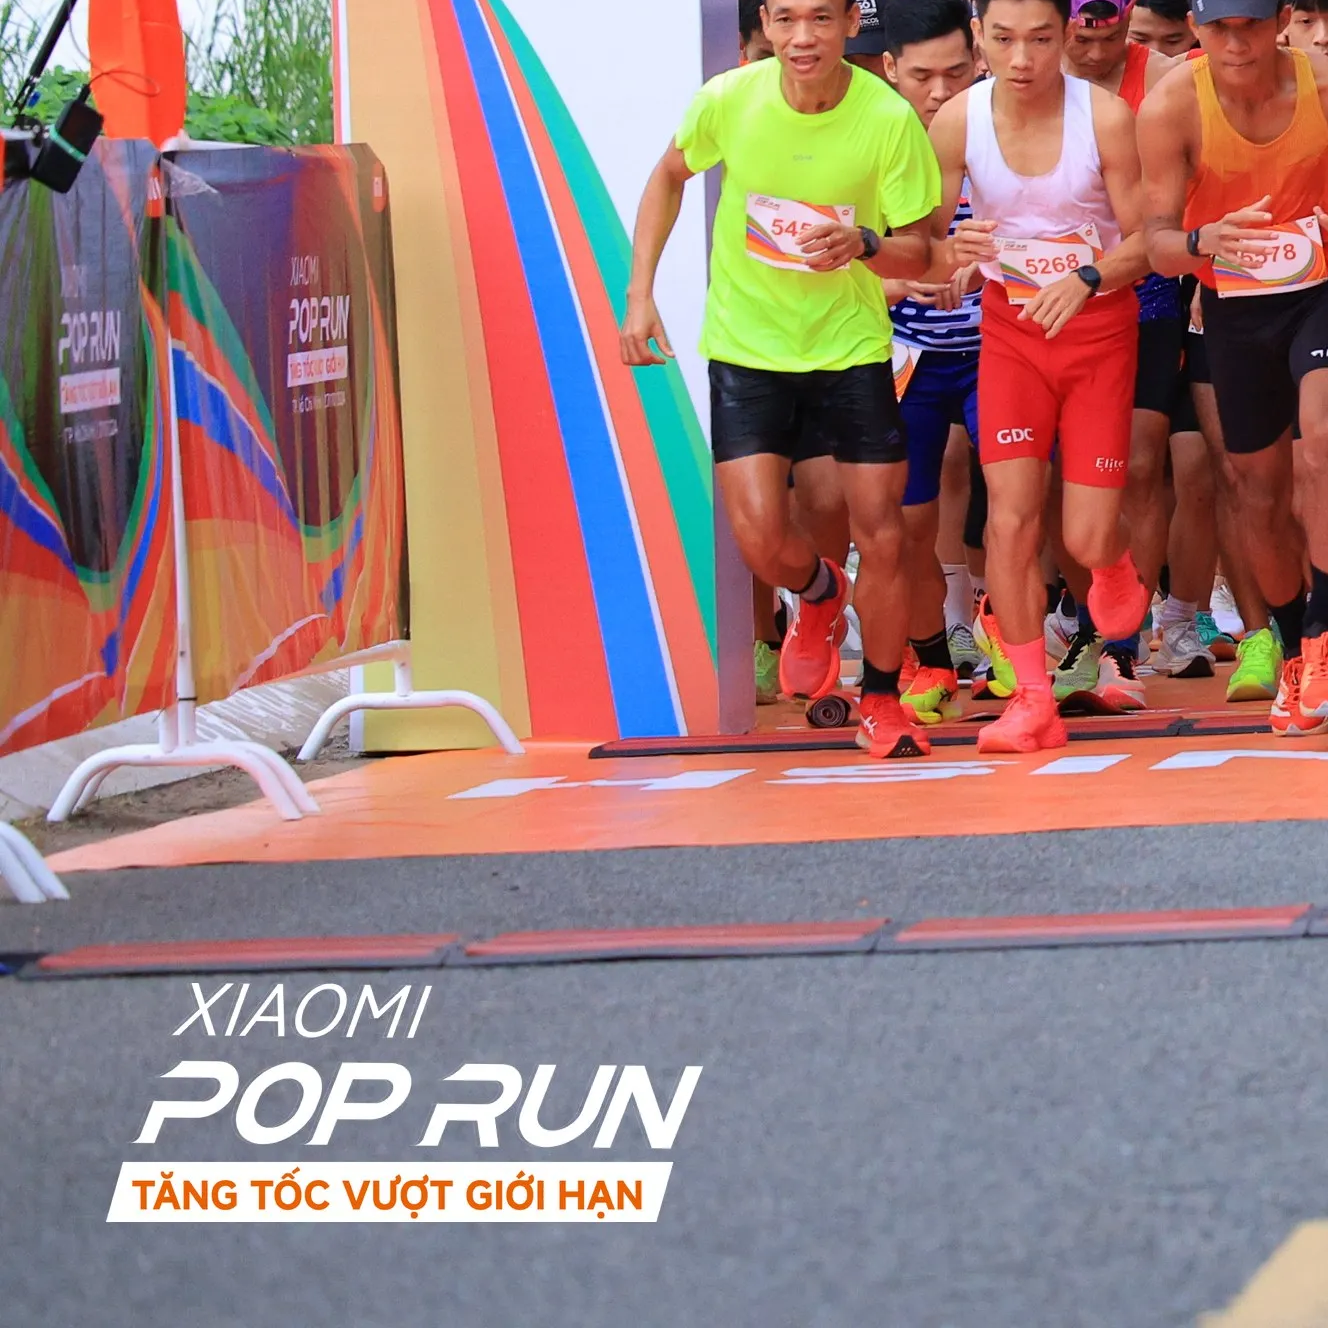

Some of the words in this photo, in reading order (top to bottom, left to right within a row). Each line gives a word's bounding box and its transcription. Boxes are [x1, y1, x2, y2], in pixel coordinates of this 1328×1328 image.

[1025, 253, 1079, 275] 5268
[288, 297, 319, 345] POP
[320, 295, 350, 341] RUN
[58, 311, 89, 365] POP
[90, 310, 120, 362] RUN
[996, 428, 1034, 444] GDC
[1095, 457, 1124, 469] Elite
